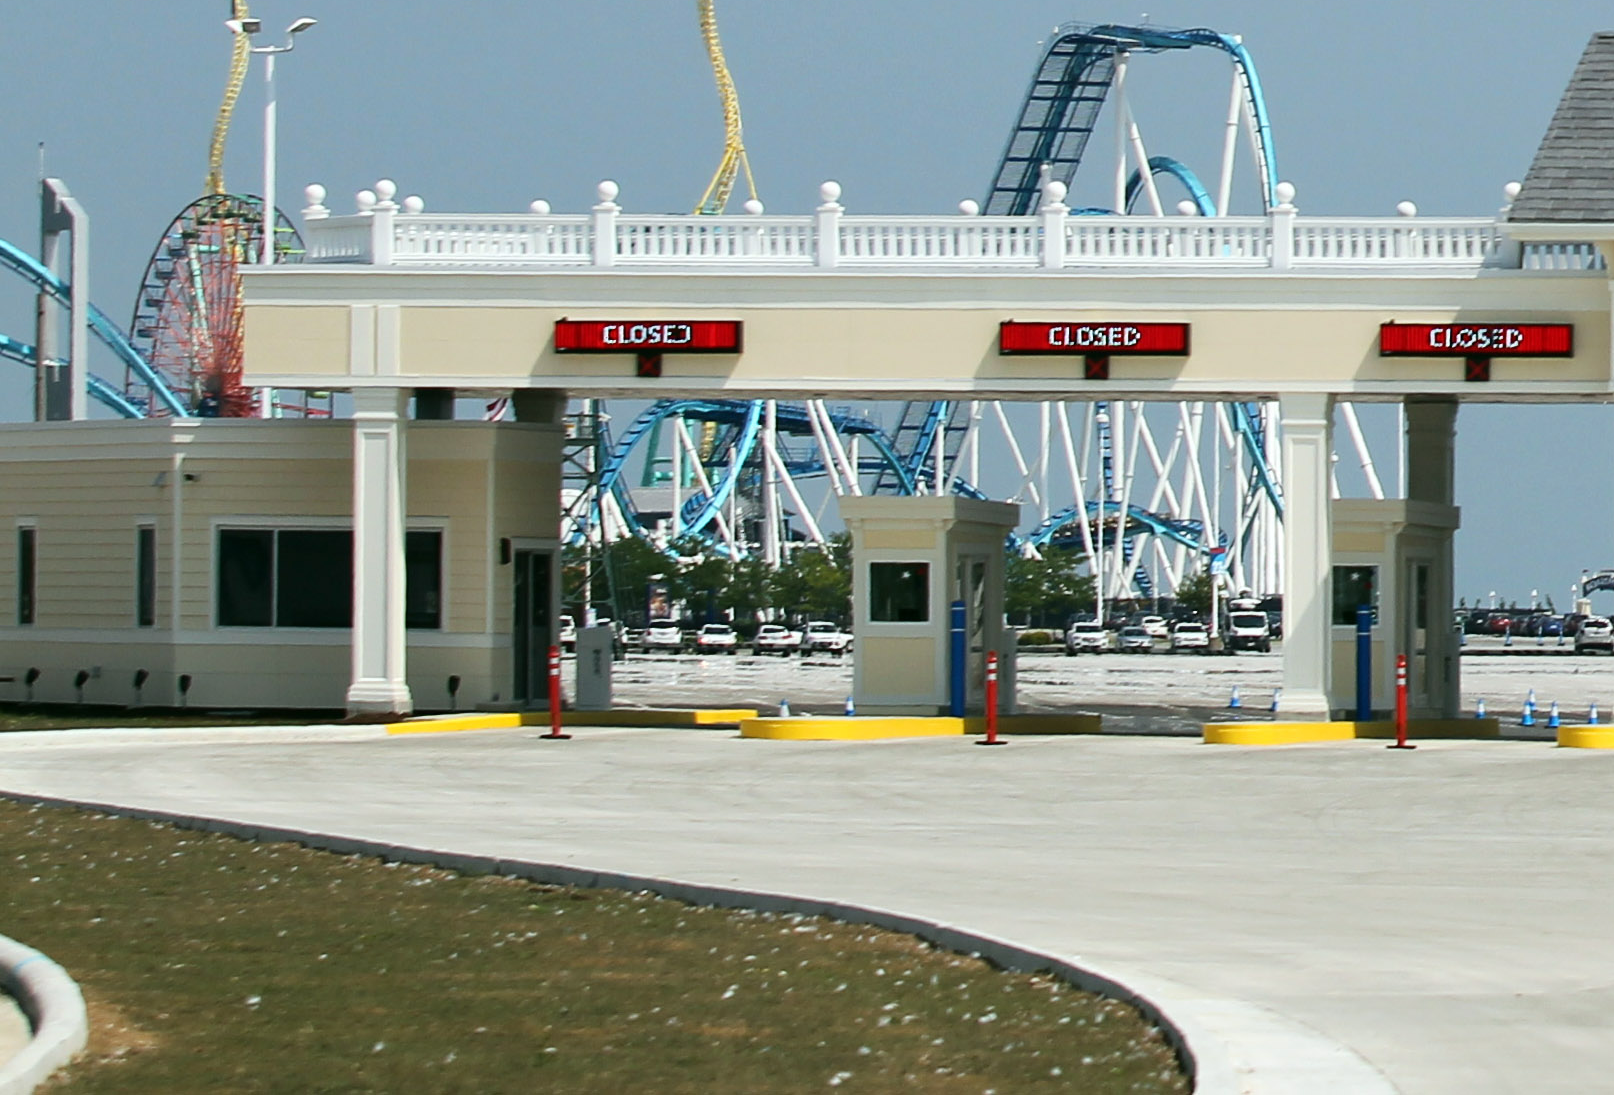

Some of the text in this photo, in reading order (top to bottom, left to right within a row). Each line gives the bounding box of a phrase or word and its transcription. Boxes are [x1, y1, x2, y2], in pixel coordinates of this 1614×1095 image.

[603, 325, 691, 345] CLOSED
[1048, 327, 1141, 346] CLOSED
[1429, 328, 1523, 348] CLOSED
